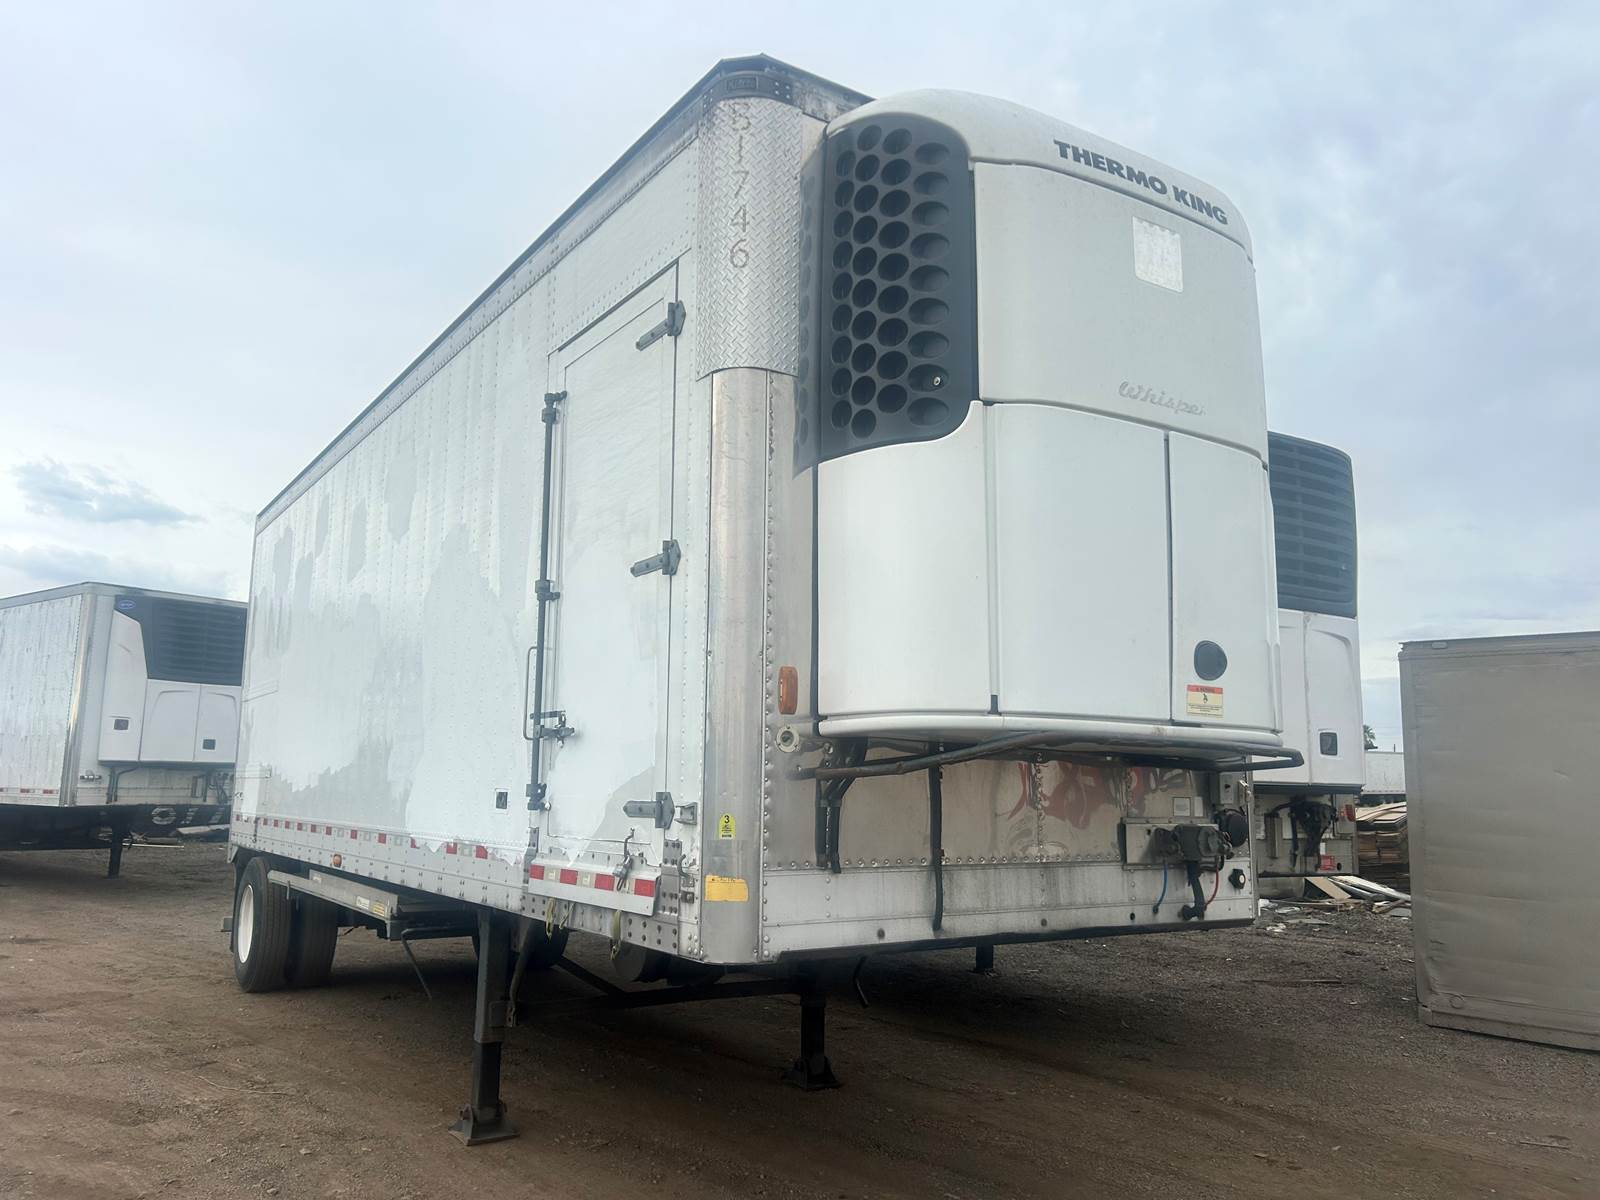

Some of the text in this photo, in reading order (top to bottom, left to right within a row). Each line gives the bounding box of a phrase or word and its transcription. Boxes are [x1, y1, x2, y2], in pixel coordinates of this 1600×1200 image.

[1053, 140, 1228, 225] THERMO KING
[724, 814, 730, 824] 3
